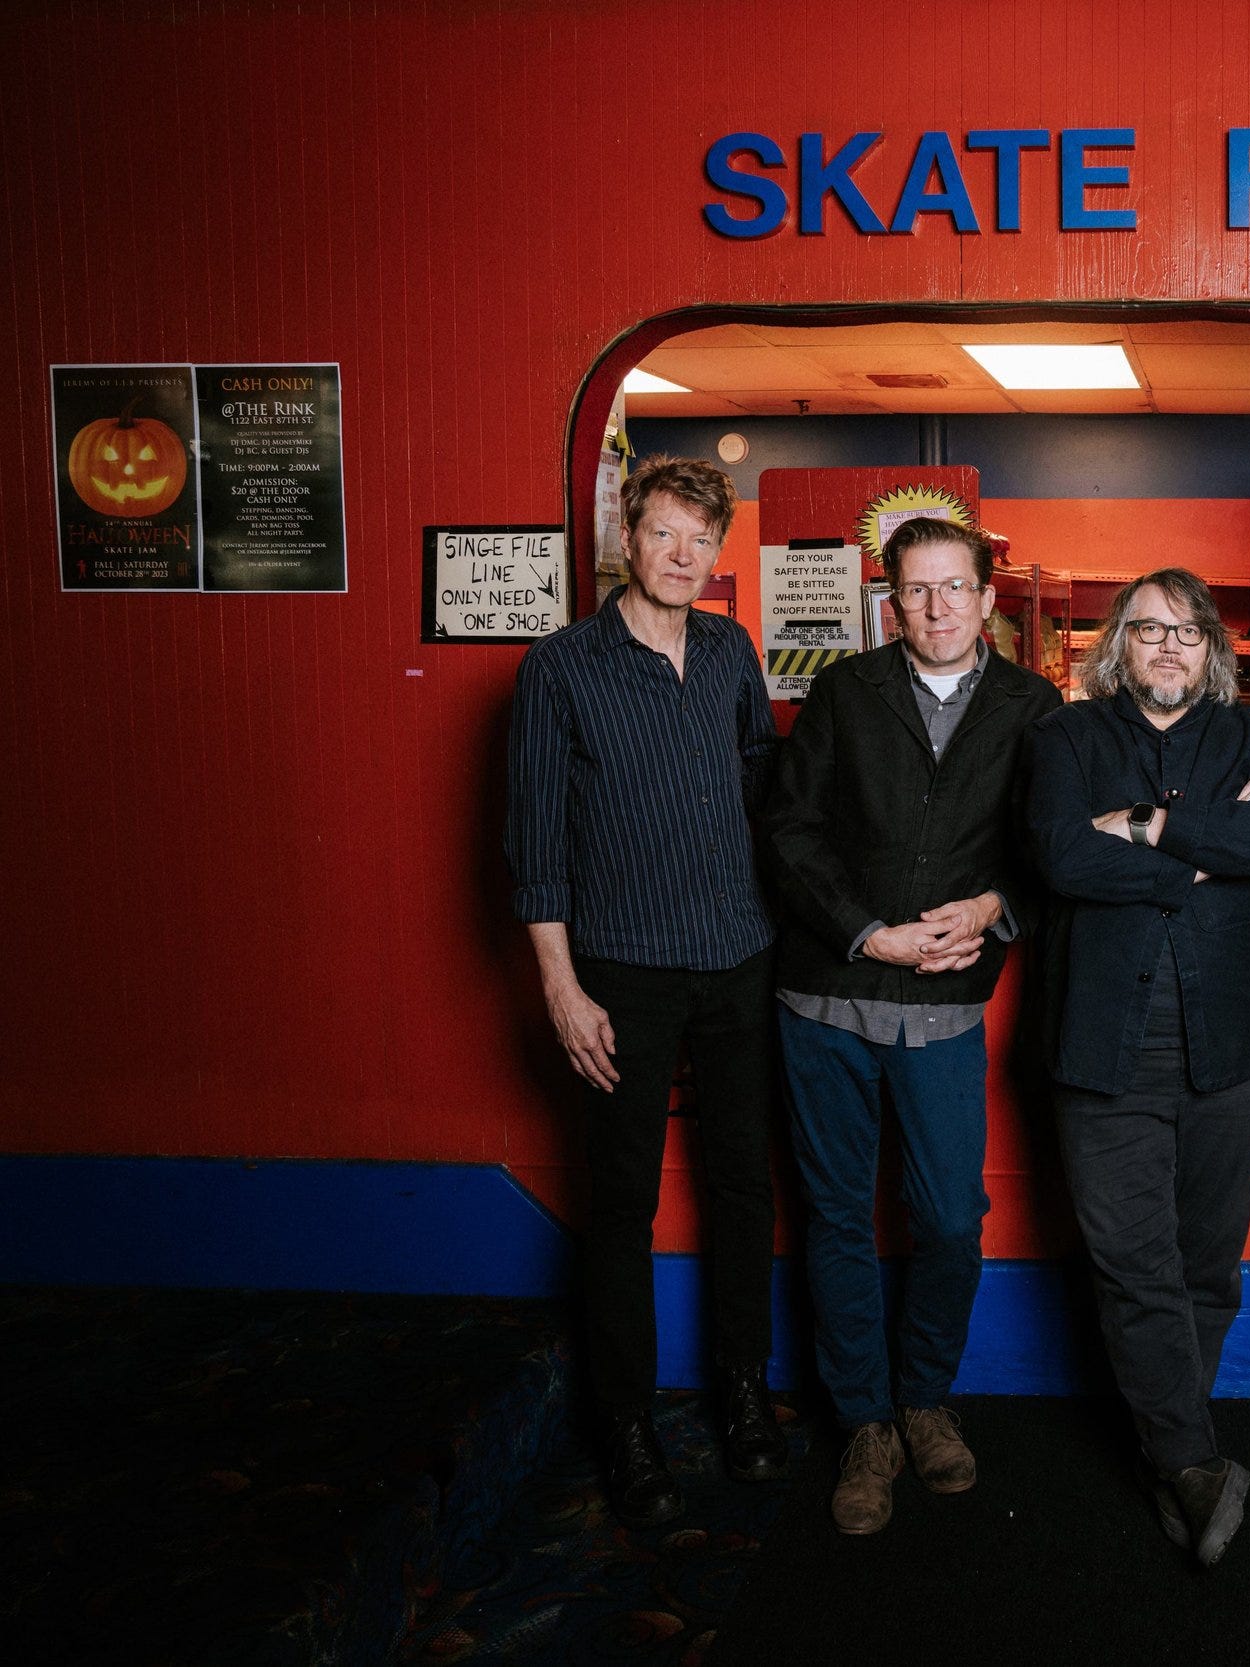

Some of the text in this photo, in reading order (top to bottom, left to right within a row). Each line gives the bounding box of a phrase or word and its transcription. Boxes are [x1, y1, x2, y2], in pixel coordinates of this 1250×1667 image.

[703, 128, 1138, 238] SKATE
[138, 377, 182, 386] PRESENTS
[221, 378, 313, 392] CA$H ONLY!
[274, 401, 316, 416] RINK
[231, 416, 314, 425] 1122 EAST 87TH ST.
[269, 447, 294, 455] GUEST
[219, 463, 246, 472] TIME:
[247, 463, 280, 472] 9:00PM
[288, 463, 321, 472] 2:00AM
[242, 478, 298, 486] ADMISSION:
[231, 486, 311, 496] $20 @ THE DOOR
[246, 496, 298, 504] CASH ONLY
[67, 524, 192, 550] HALLOWEEN
[104, 546, 133, 554] SKATE
[445, 536, 552, 559] SINGE FILE
[786, 554, 834, 563] FOR YOUR
[94, 561, 114, 569] FALL
[124, 561, 169, 569] SATURDAY
[94, 570, 133, 578] OCTOBER
[151, 570, 169, 578] 2023
[471, 562, 515, 584] LINE
[774, 567, 848, 576] SAFETY PLEASE
[803, 580, 835, 588] SITTED
[441, 589, 536, 606] ONLY NEED
[775, 593, 845, 602] WHEN PUTTING
[772, 606, 851, 615] ON/OFF RENTALS
[506, 612, 551, 632] SHOE
